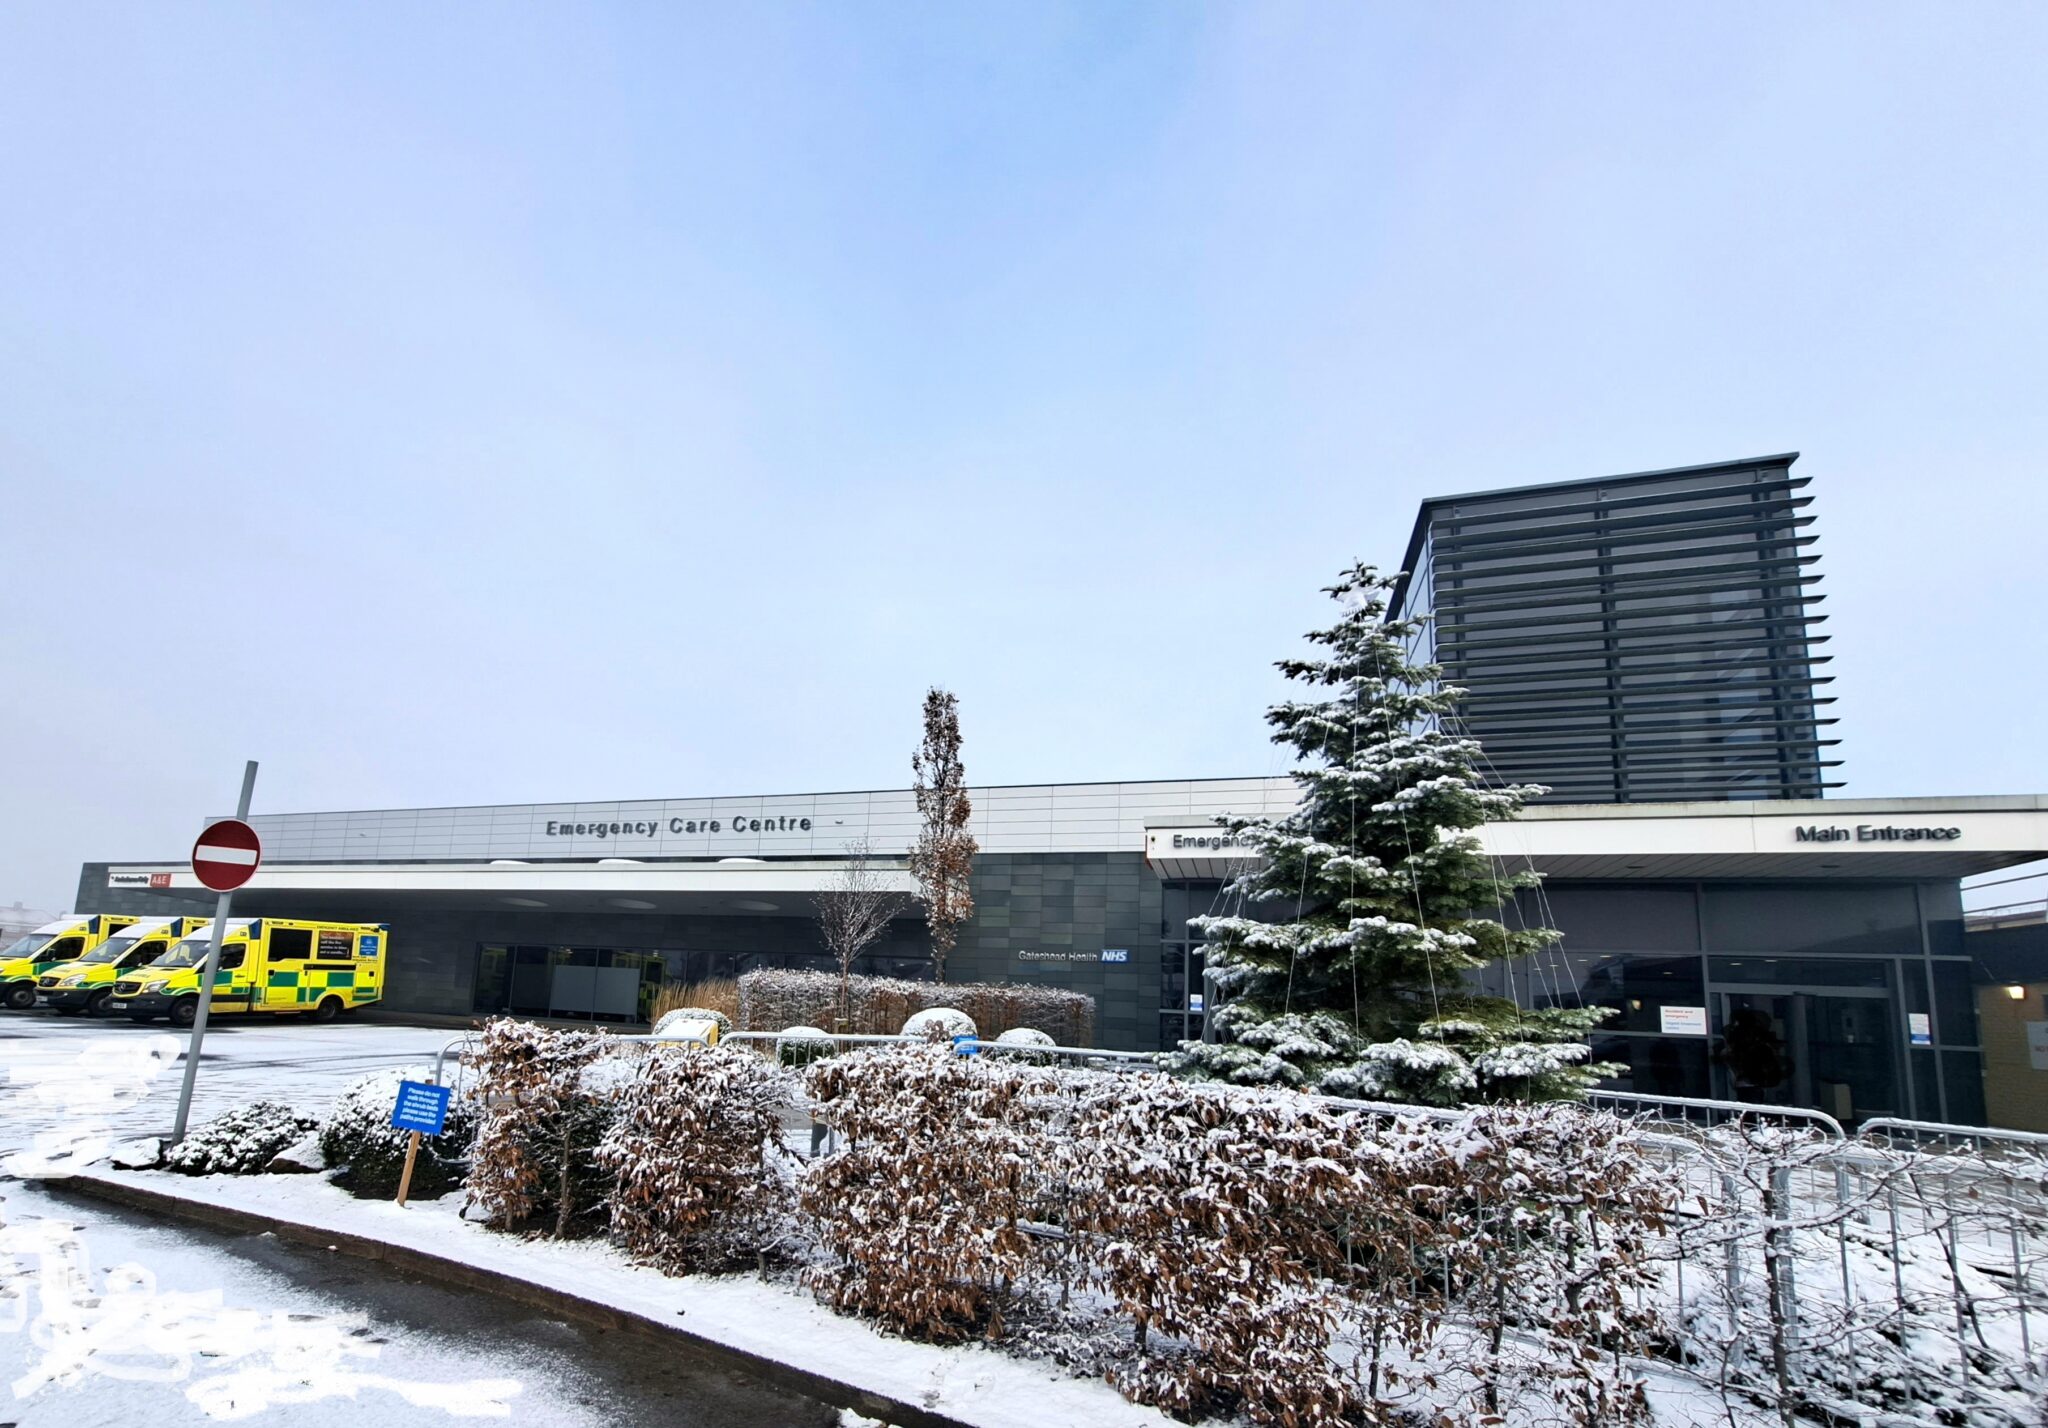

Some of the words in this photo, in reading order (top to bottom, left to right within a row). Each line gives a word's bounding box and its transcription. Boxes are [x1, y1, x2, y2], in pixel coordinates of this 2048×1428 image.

[546, 820, 658, 838] Emergency
[670, 817, 721, 834] Care
[732, 815, 812, 832] Centre
[1795, 825, 1850, 842] Main
[1856, 824, 1961, 841] Entrance
[1173, 834, 1254, 850] Emergenc
[152, 875, 168, 884] A&E
[1018, 950, 1066, 961] Gateshead
[1069, 952, 1098, 962] Health
[1101, 950, 1128, 962] NHS
[408, 1087, 425, 1095] Please
